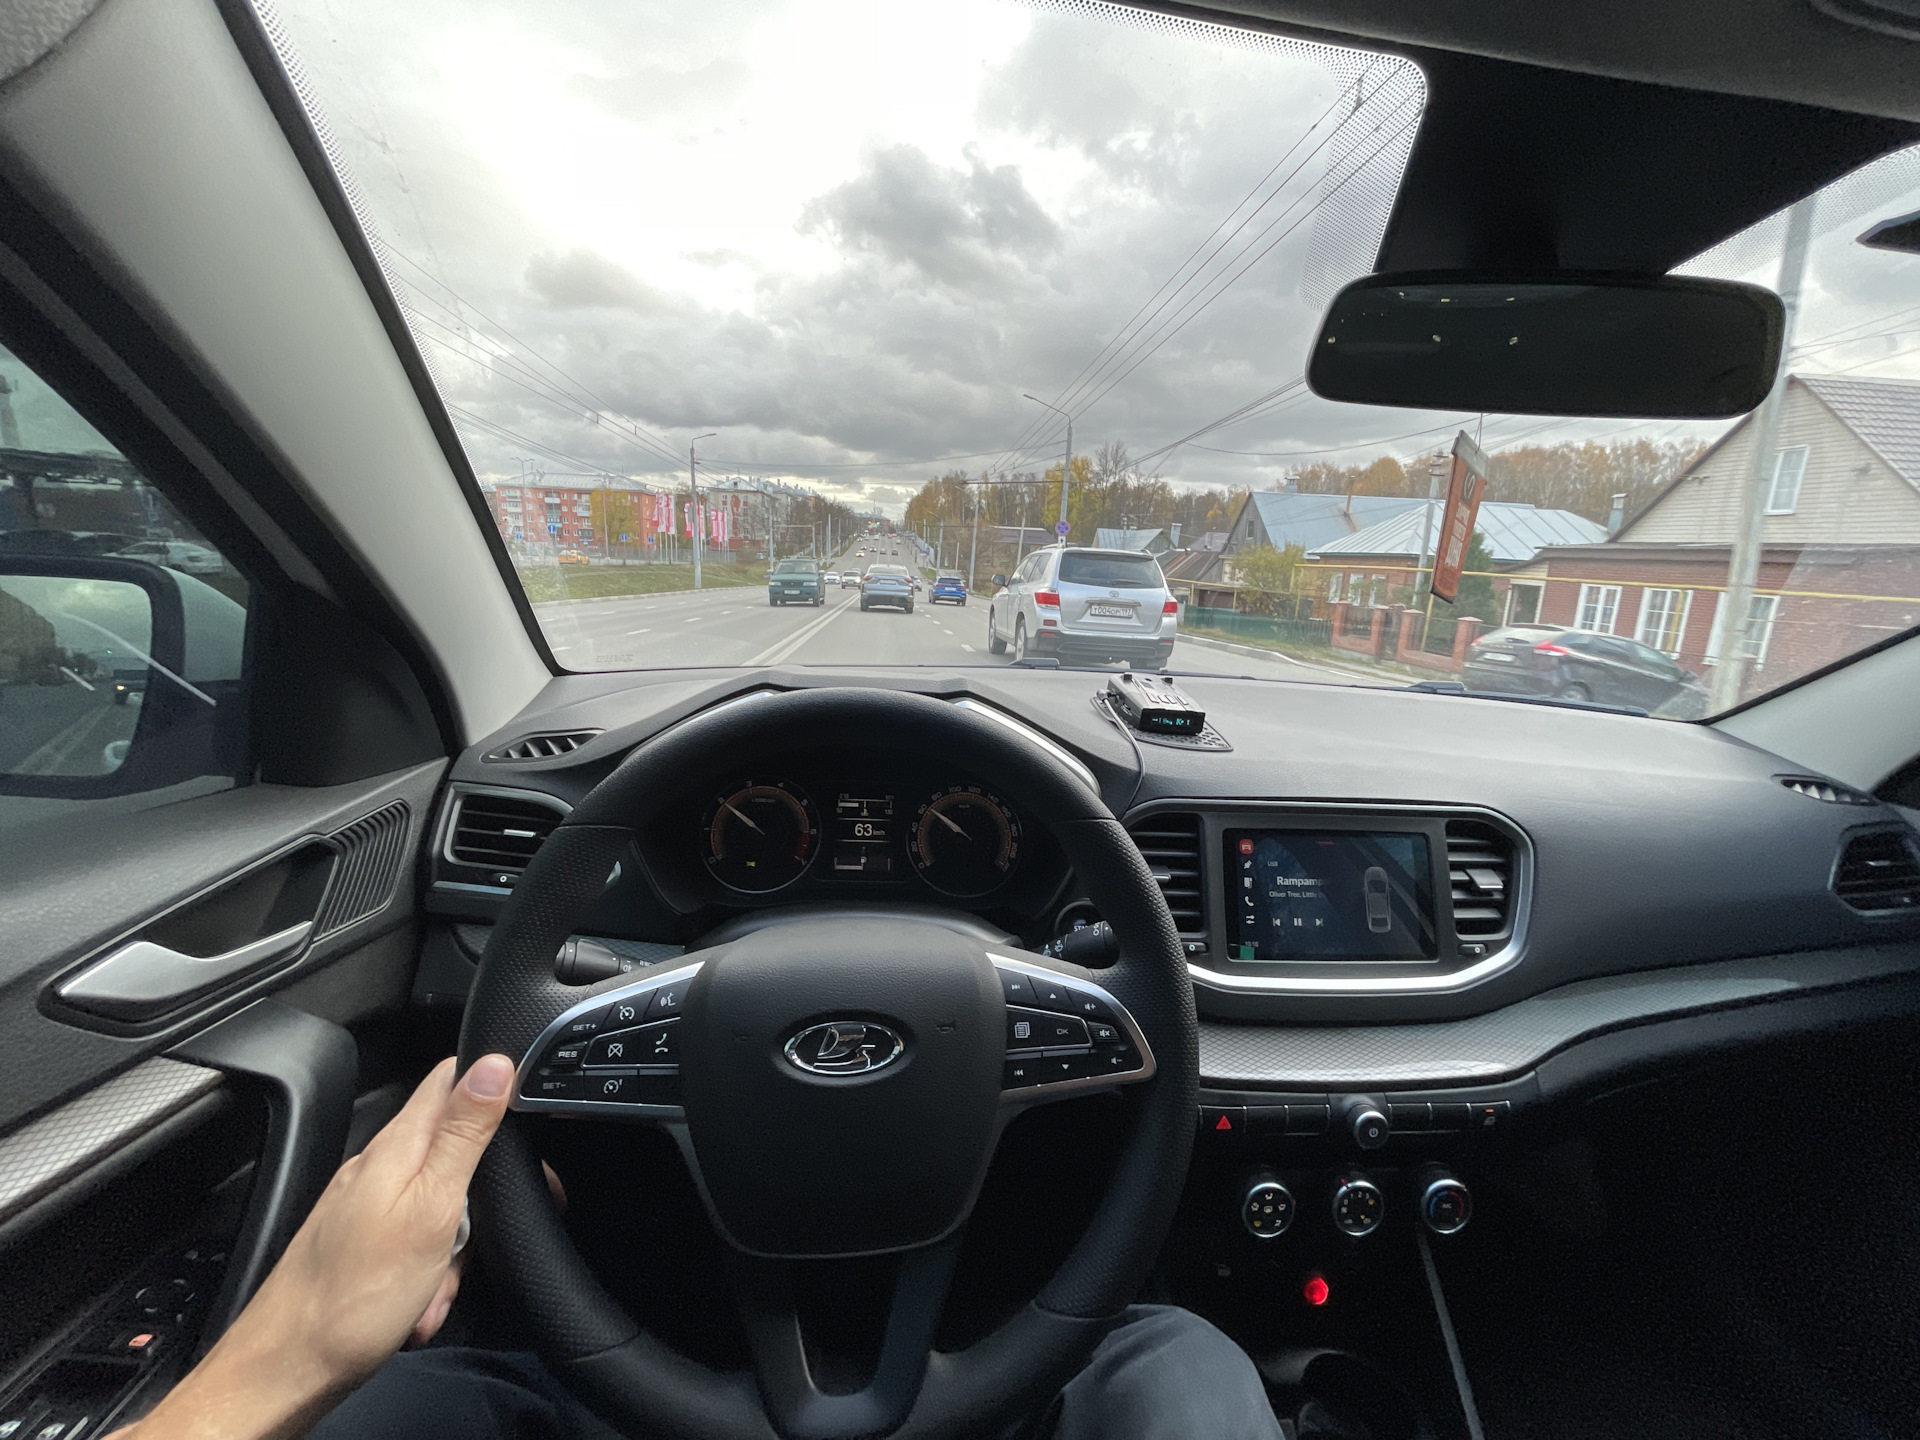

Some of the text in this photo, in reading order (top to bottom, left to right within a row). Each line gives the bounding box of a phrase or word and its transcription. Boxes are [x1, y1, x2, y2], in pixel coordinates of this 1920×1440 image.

[948, 785, 962, 793] 100
[967, 785, 981, 794] 120
[930, 791, 942, 801] 80
[917, 803, 928, 815] 60
[854, 823, 873, 837] 63
[911, 821, 919, 833] 40
[1010, 842, 1018, 858] 200
[1268, 890, 1287, 898] Oliver
[572, 1023, 597, 1032] SET+
[1056, 1027, 1069, 1035] OK
[557, 1050, 578, 1059] RES
[542, 1082, 567, 1090] SET-
